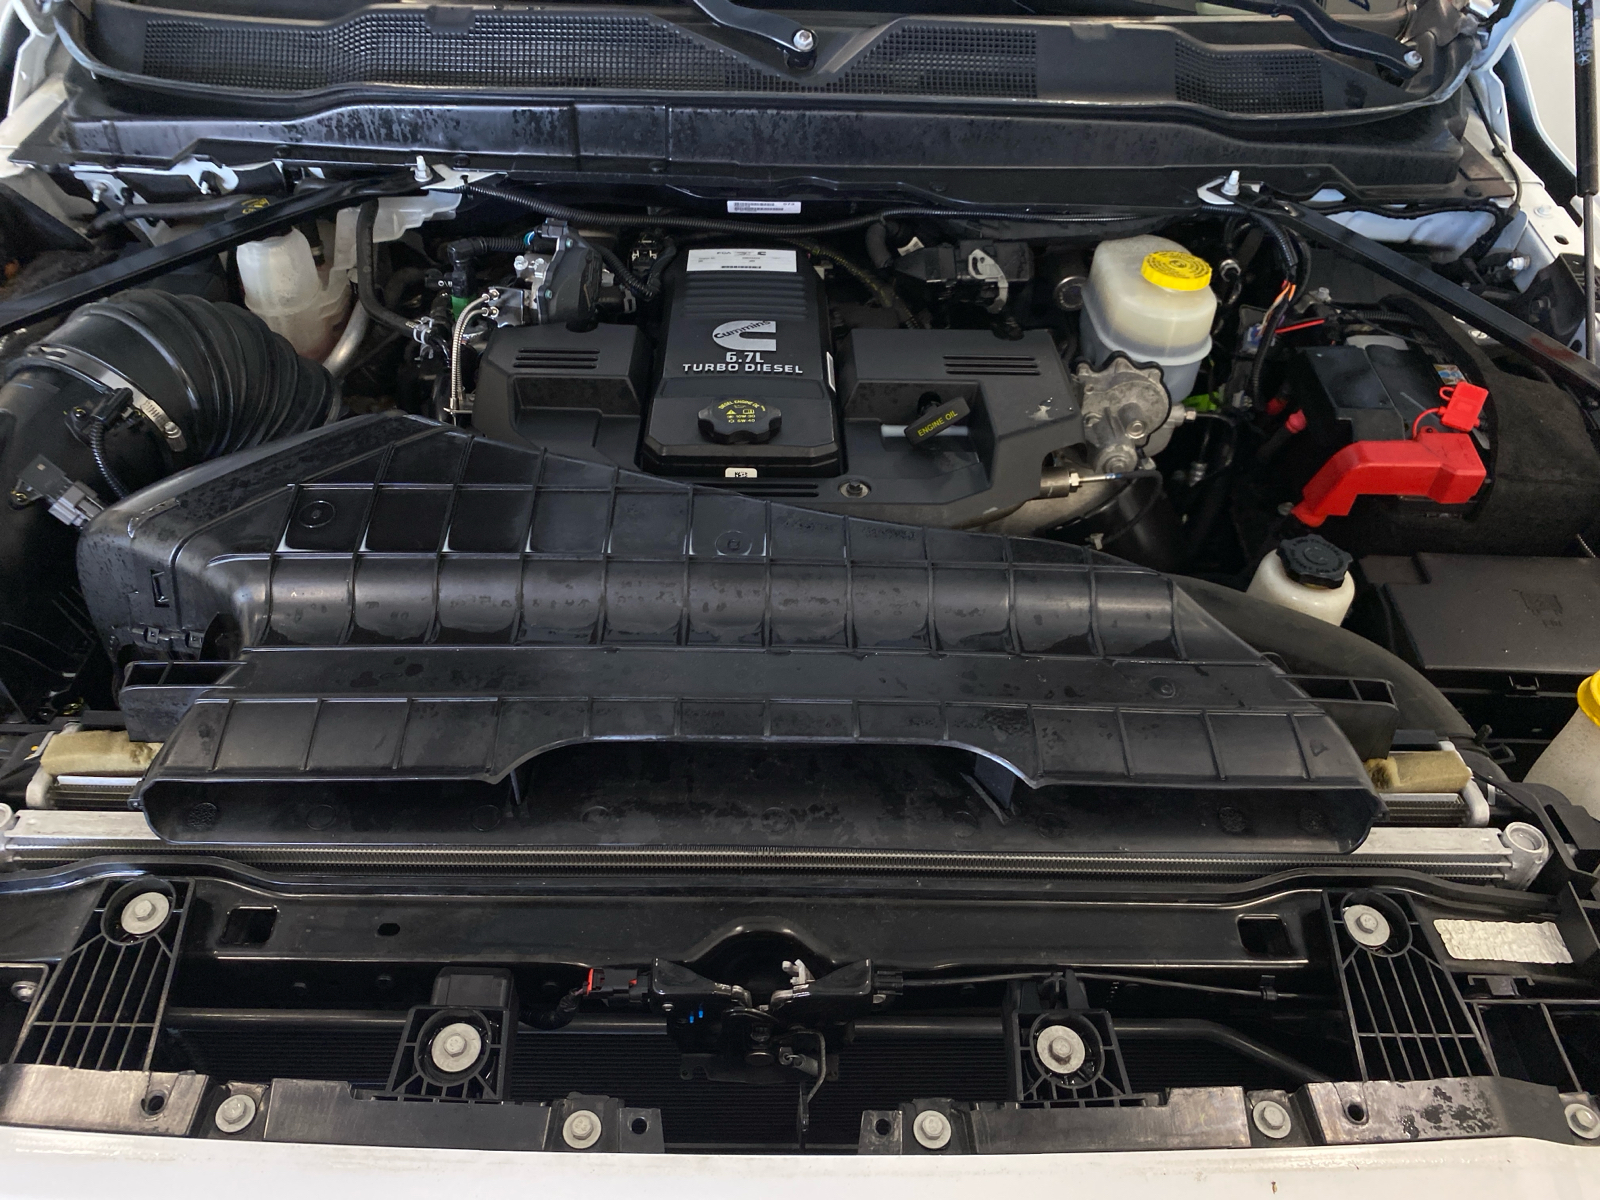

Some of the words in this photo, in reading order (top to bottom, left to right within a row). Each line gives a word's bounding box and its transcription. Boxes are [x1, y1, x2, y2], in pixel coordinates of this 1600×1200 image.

[726, 352, 764, 362] 6.7L
[683, 363, 739, 372] TURBO
[745, 363, 803, 373] DIESEL
[917, 417, 945, 437] ENGINE
[945, 410, 959, 421] OIL
